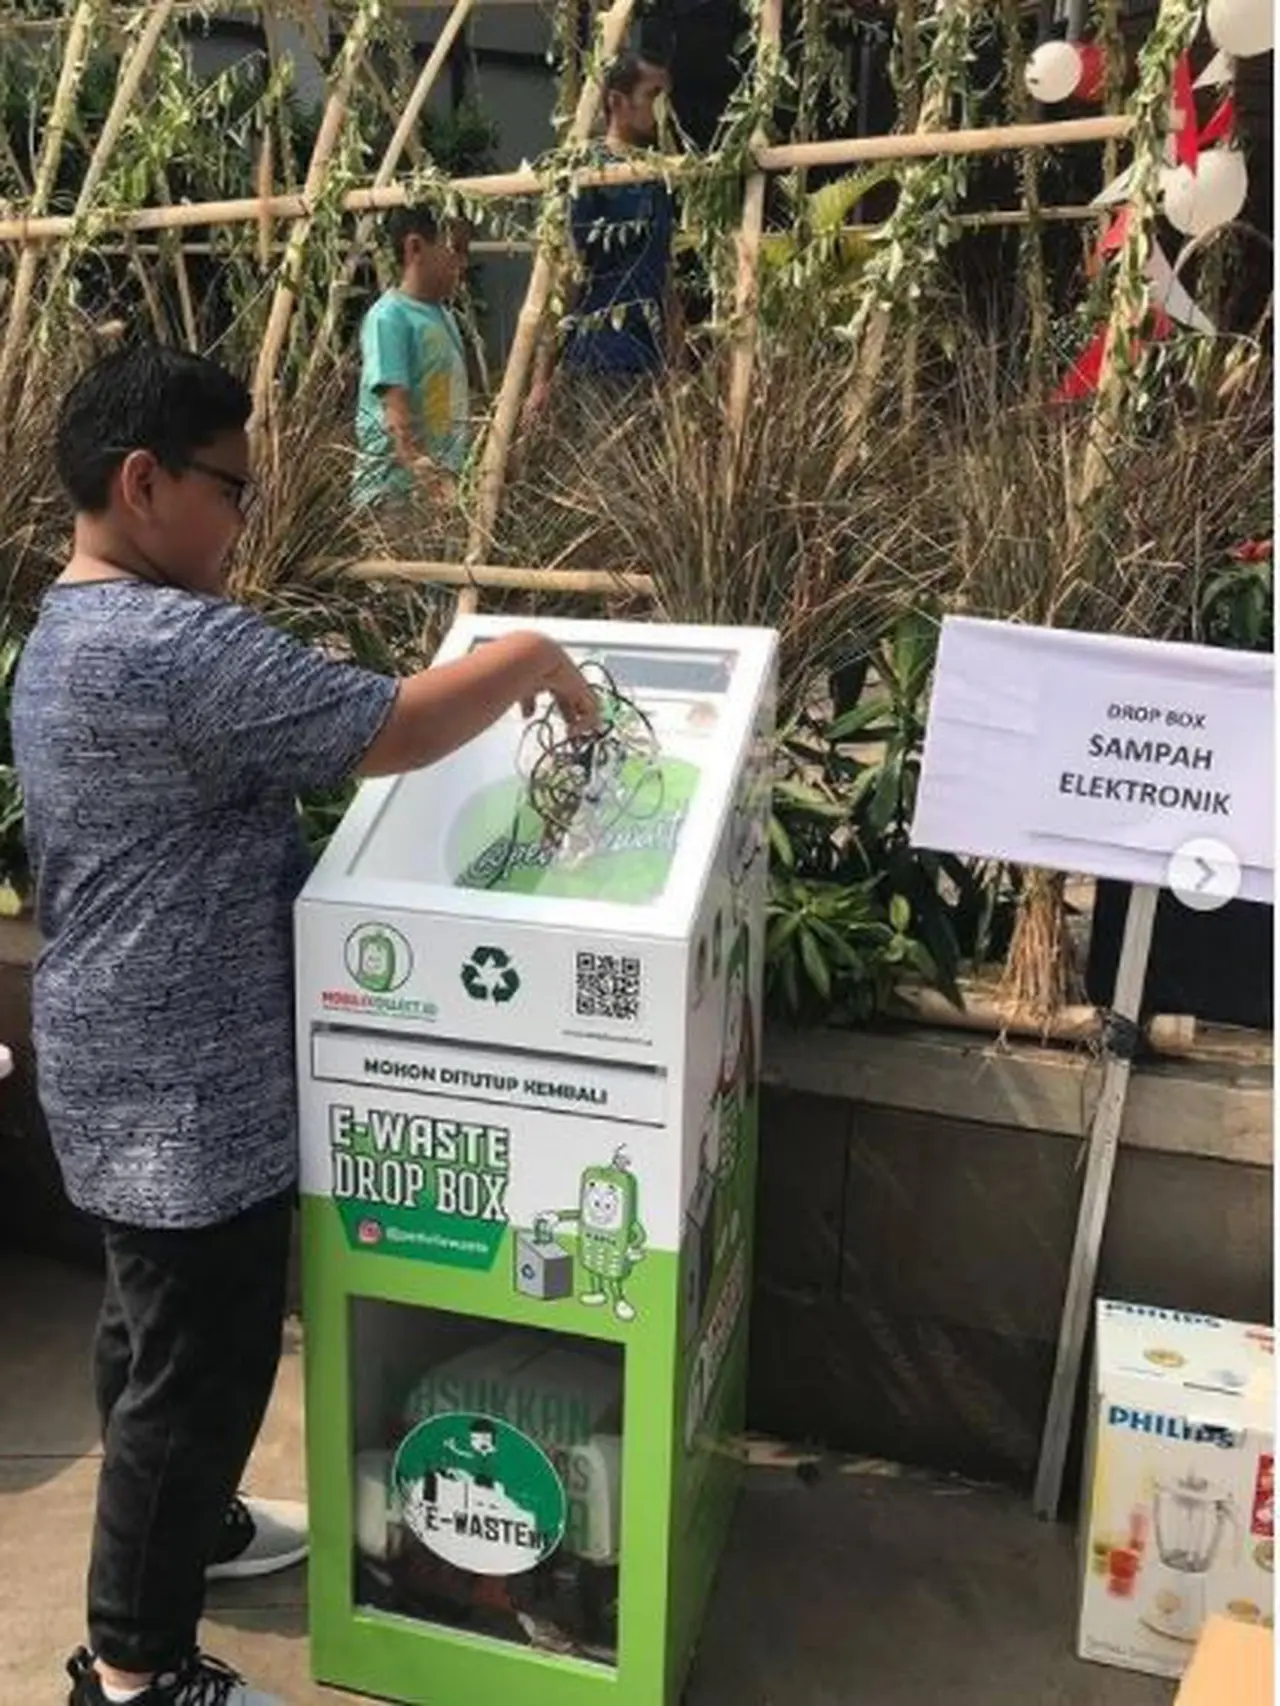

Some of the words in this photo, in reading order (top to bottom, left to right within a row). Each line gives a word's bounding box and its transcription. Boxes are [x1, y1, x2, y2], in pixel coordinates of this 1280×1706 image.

[1107, 703, 1161, 723] DROP
[1165, 711, 1207, 729] BOX
[1088, 733, 1213, 770] SAMPAH
[1059, 772, 1231, 815] ELEKTRONIK
[364, 1057, 435, 1080] MOHON
[440, 1067, 519, 1091] DITUTUP
[523, 1079, 608, 1105] KEMBALI
[330, 1104, 508, 1169] E-WASTE
[333, 1150, 425, 1208] DROP
[435, 1167, 508, 1222] BOX
